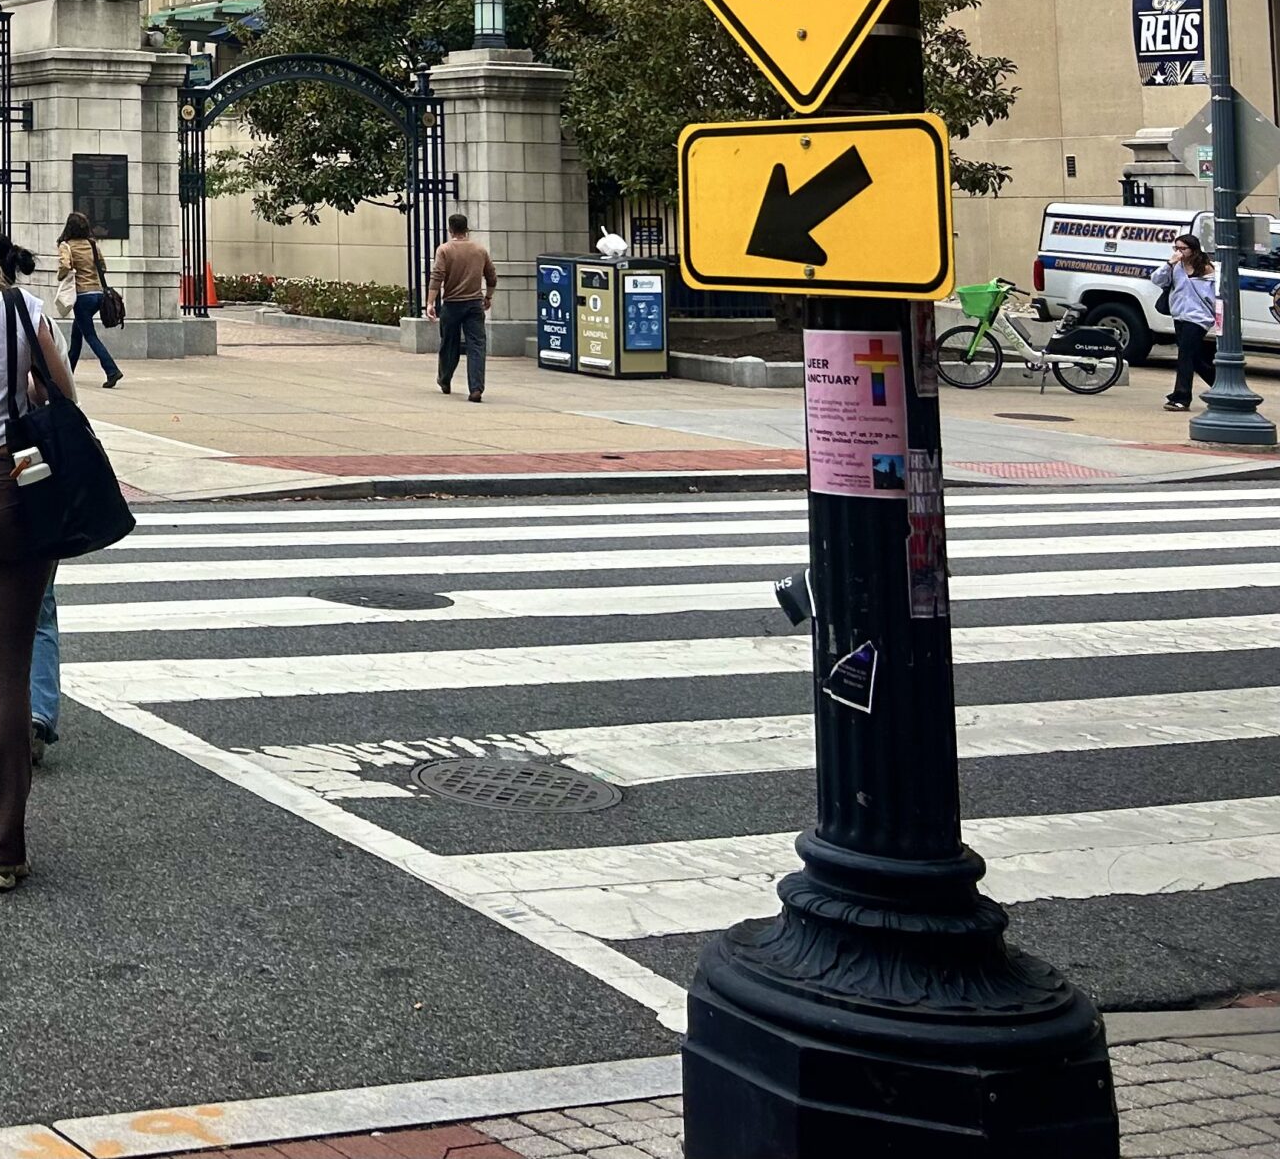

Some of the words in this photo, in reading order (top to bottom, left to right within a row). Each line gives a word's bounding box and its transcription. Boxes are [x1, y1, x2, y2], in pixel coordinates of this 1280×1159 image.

[1138, 12, 1201, 52] REVS
[1051, 221, 1120, 240] EMERGENCY
[1120, 225, 1177, 243] SERVICES
[1054, 259, 1113, 273] ENVIRONMENTAL
[1114, 265, 1142, 277] HEALTH
[543, 324, 567, 334] RECYCLE
[582, 329, 609, 340] LANDFILL
